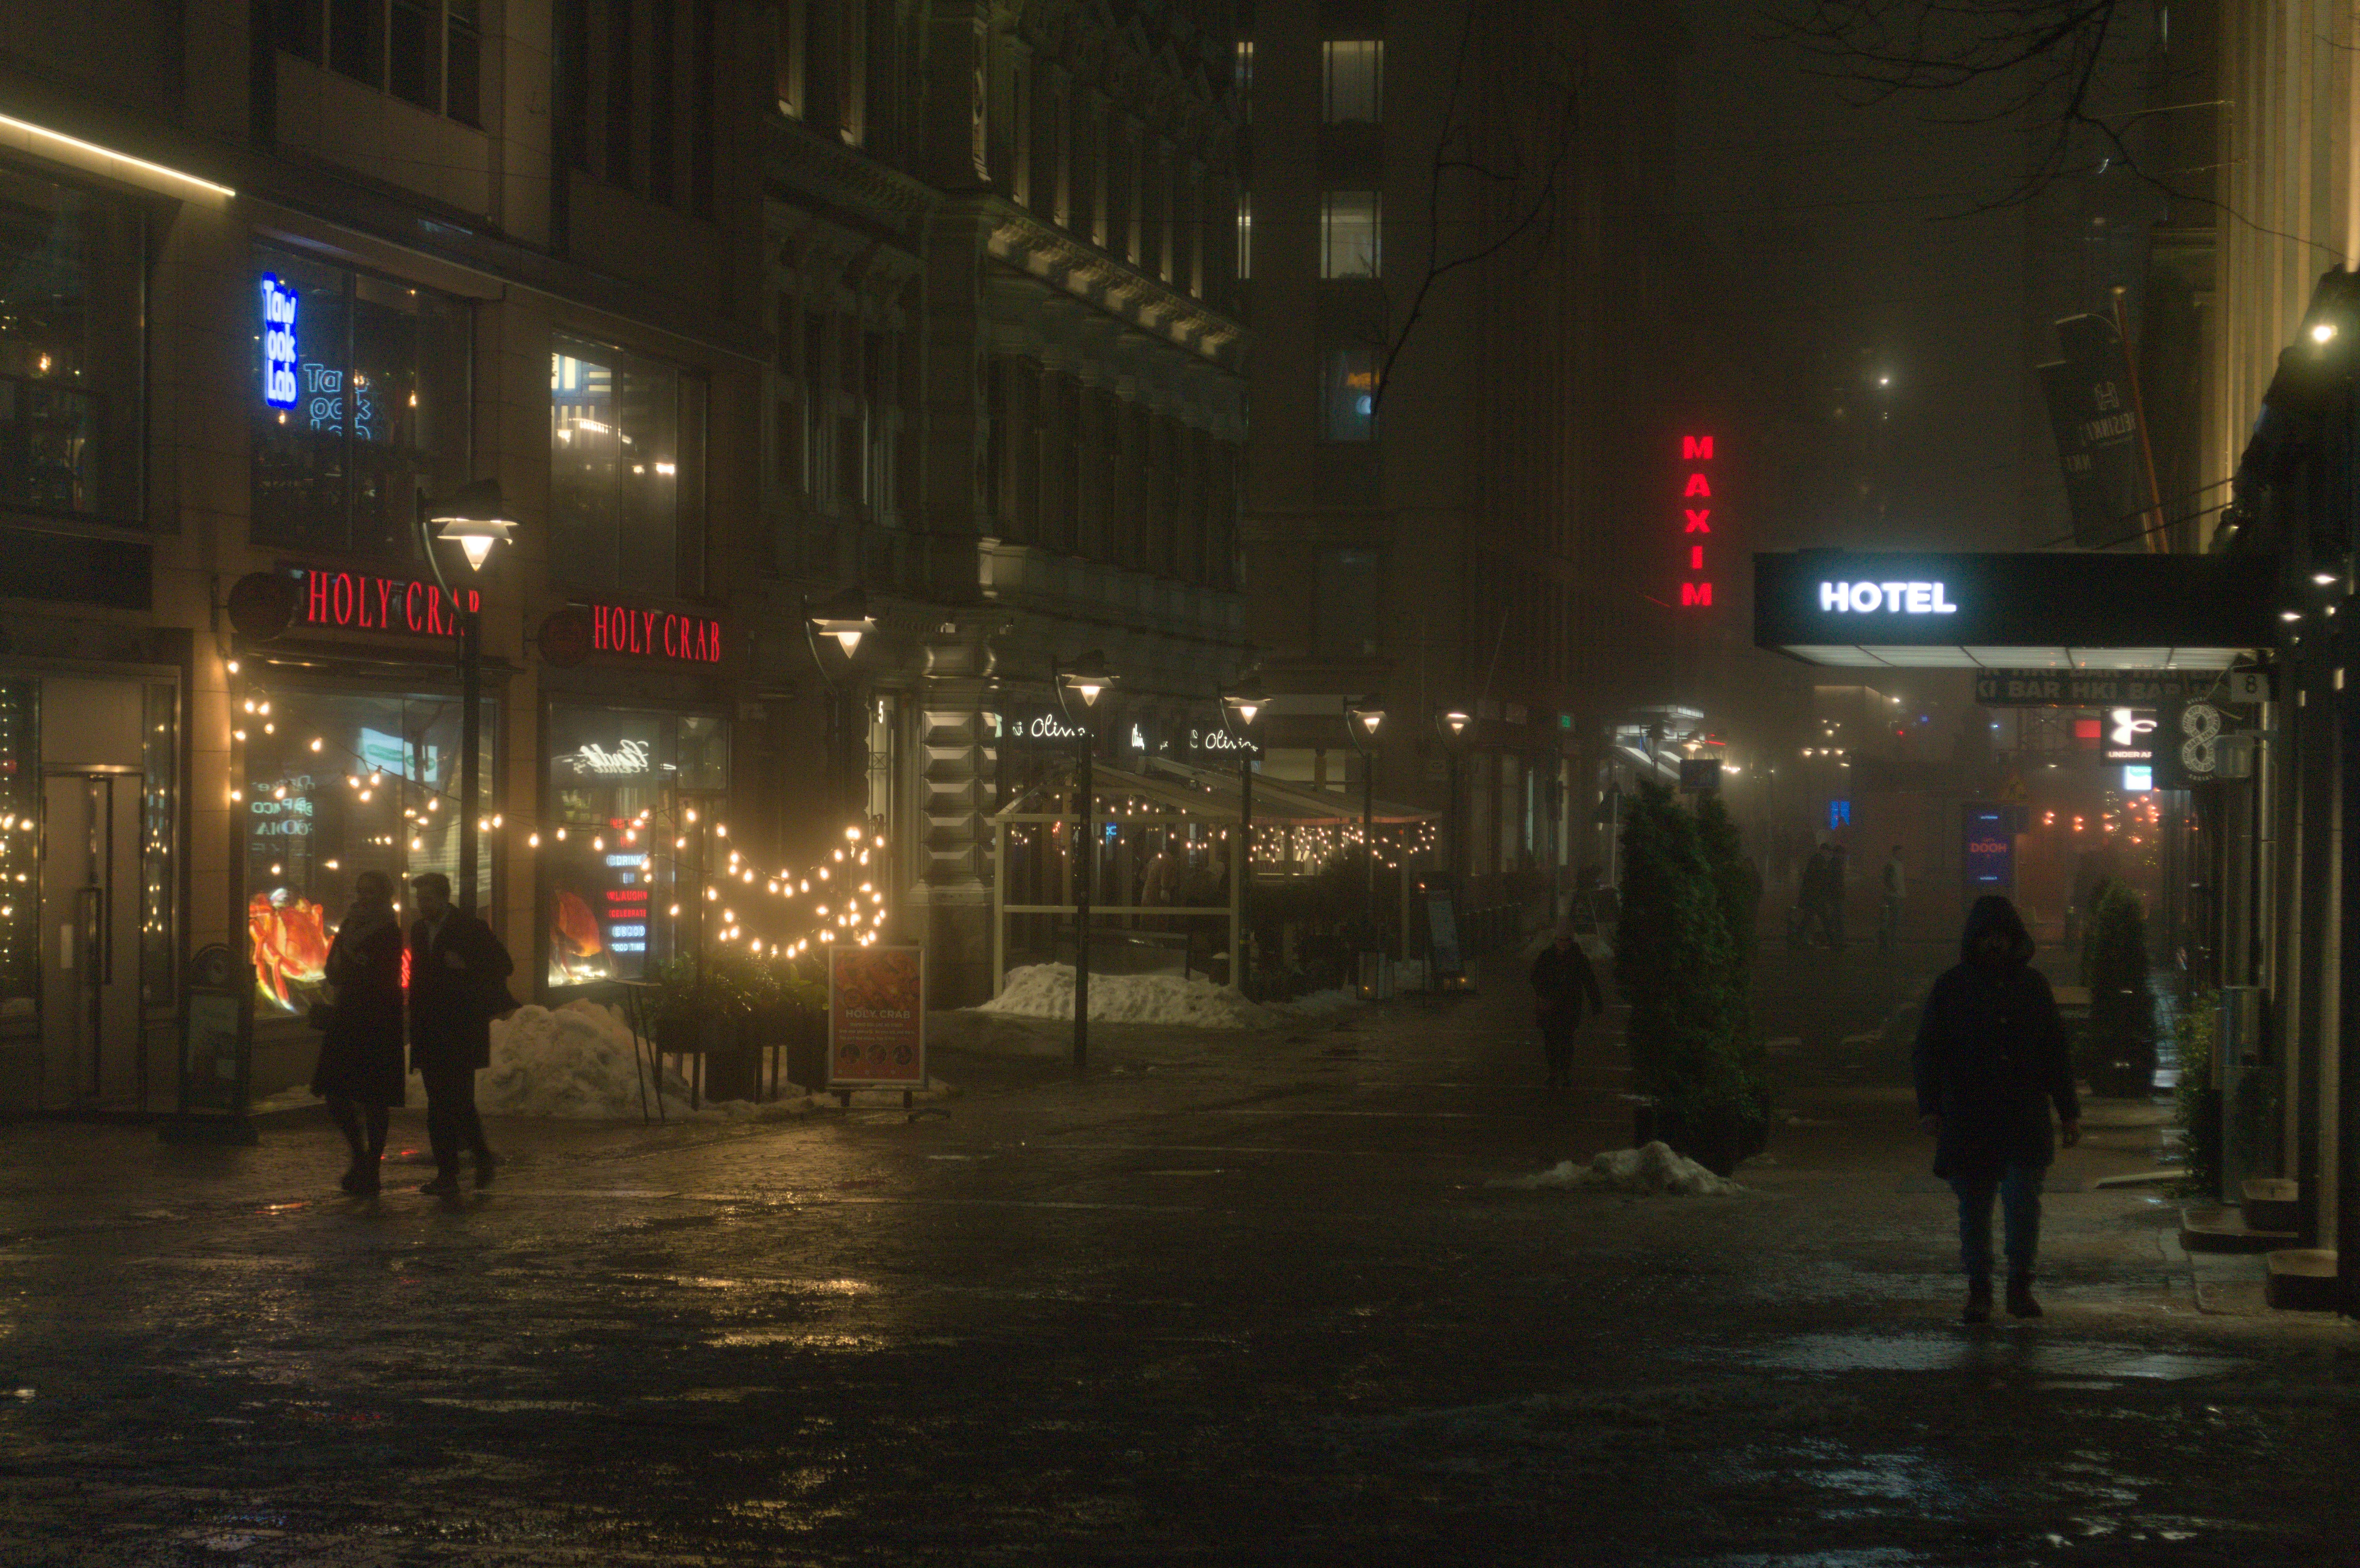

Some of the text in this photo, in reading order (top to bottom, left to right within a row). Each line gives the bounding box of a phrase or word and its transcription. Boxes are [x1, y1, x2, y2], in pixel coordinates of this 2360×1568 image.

[263, 280, 296, 324] Taw
[267, 323, 296, 363] ook
[267, 360, 296, 402] Lab
[1681, 435, 1713, 606] MAXIM
[307, 569, 392, 628] HOLY
[1820, 581, 1957, 614] HOTEL
[594, 604, 721, 662] HOLY CRAB
[2245, 674, 2257, 694] 8
[1970, 843, 2006, 853] DOOH
[616, 891, 643, 901] LAUGH
[845, 1010, 911, 1019] HOLY CRAB
